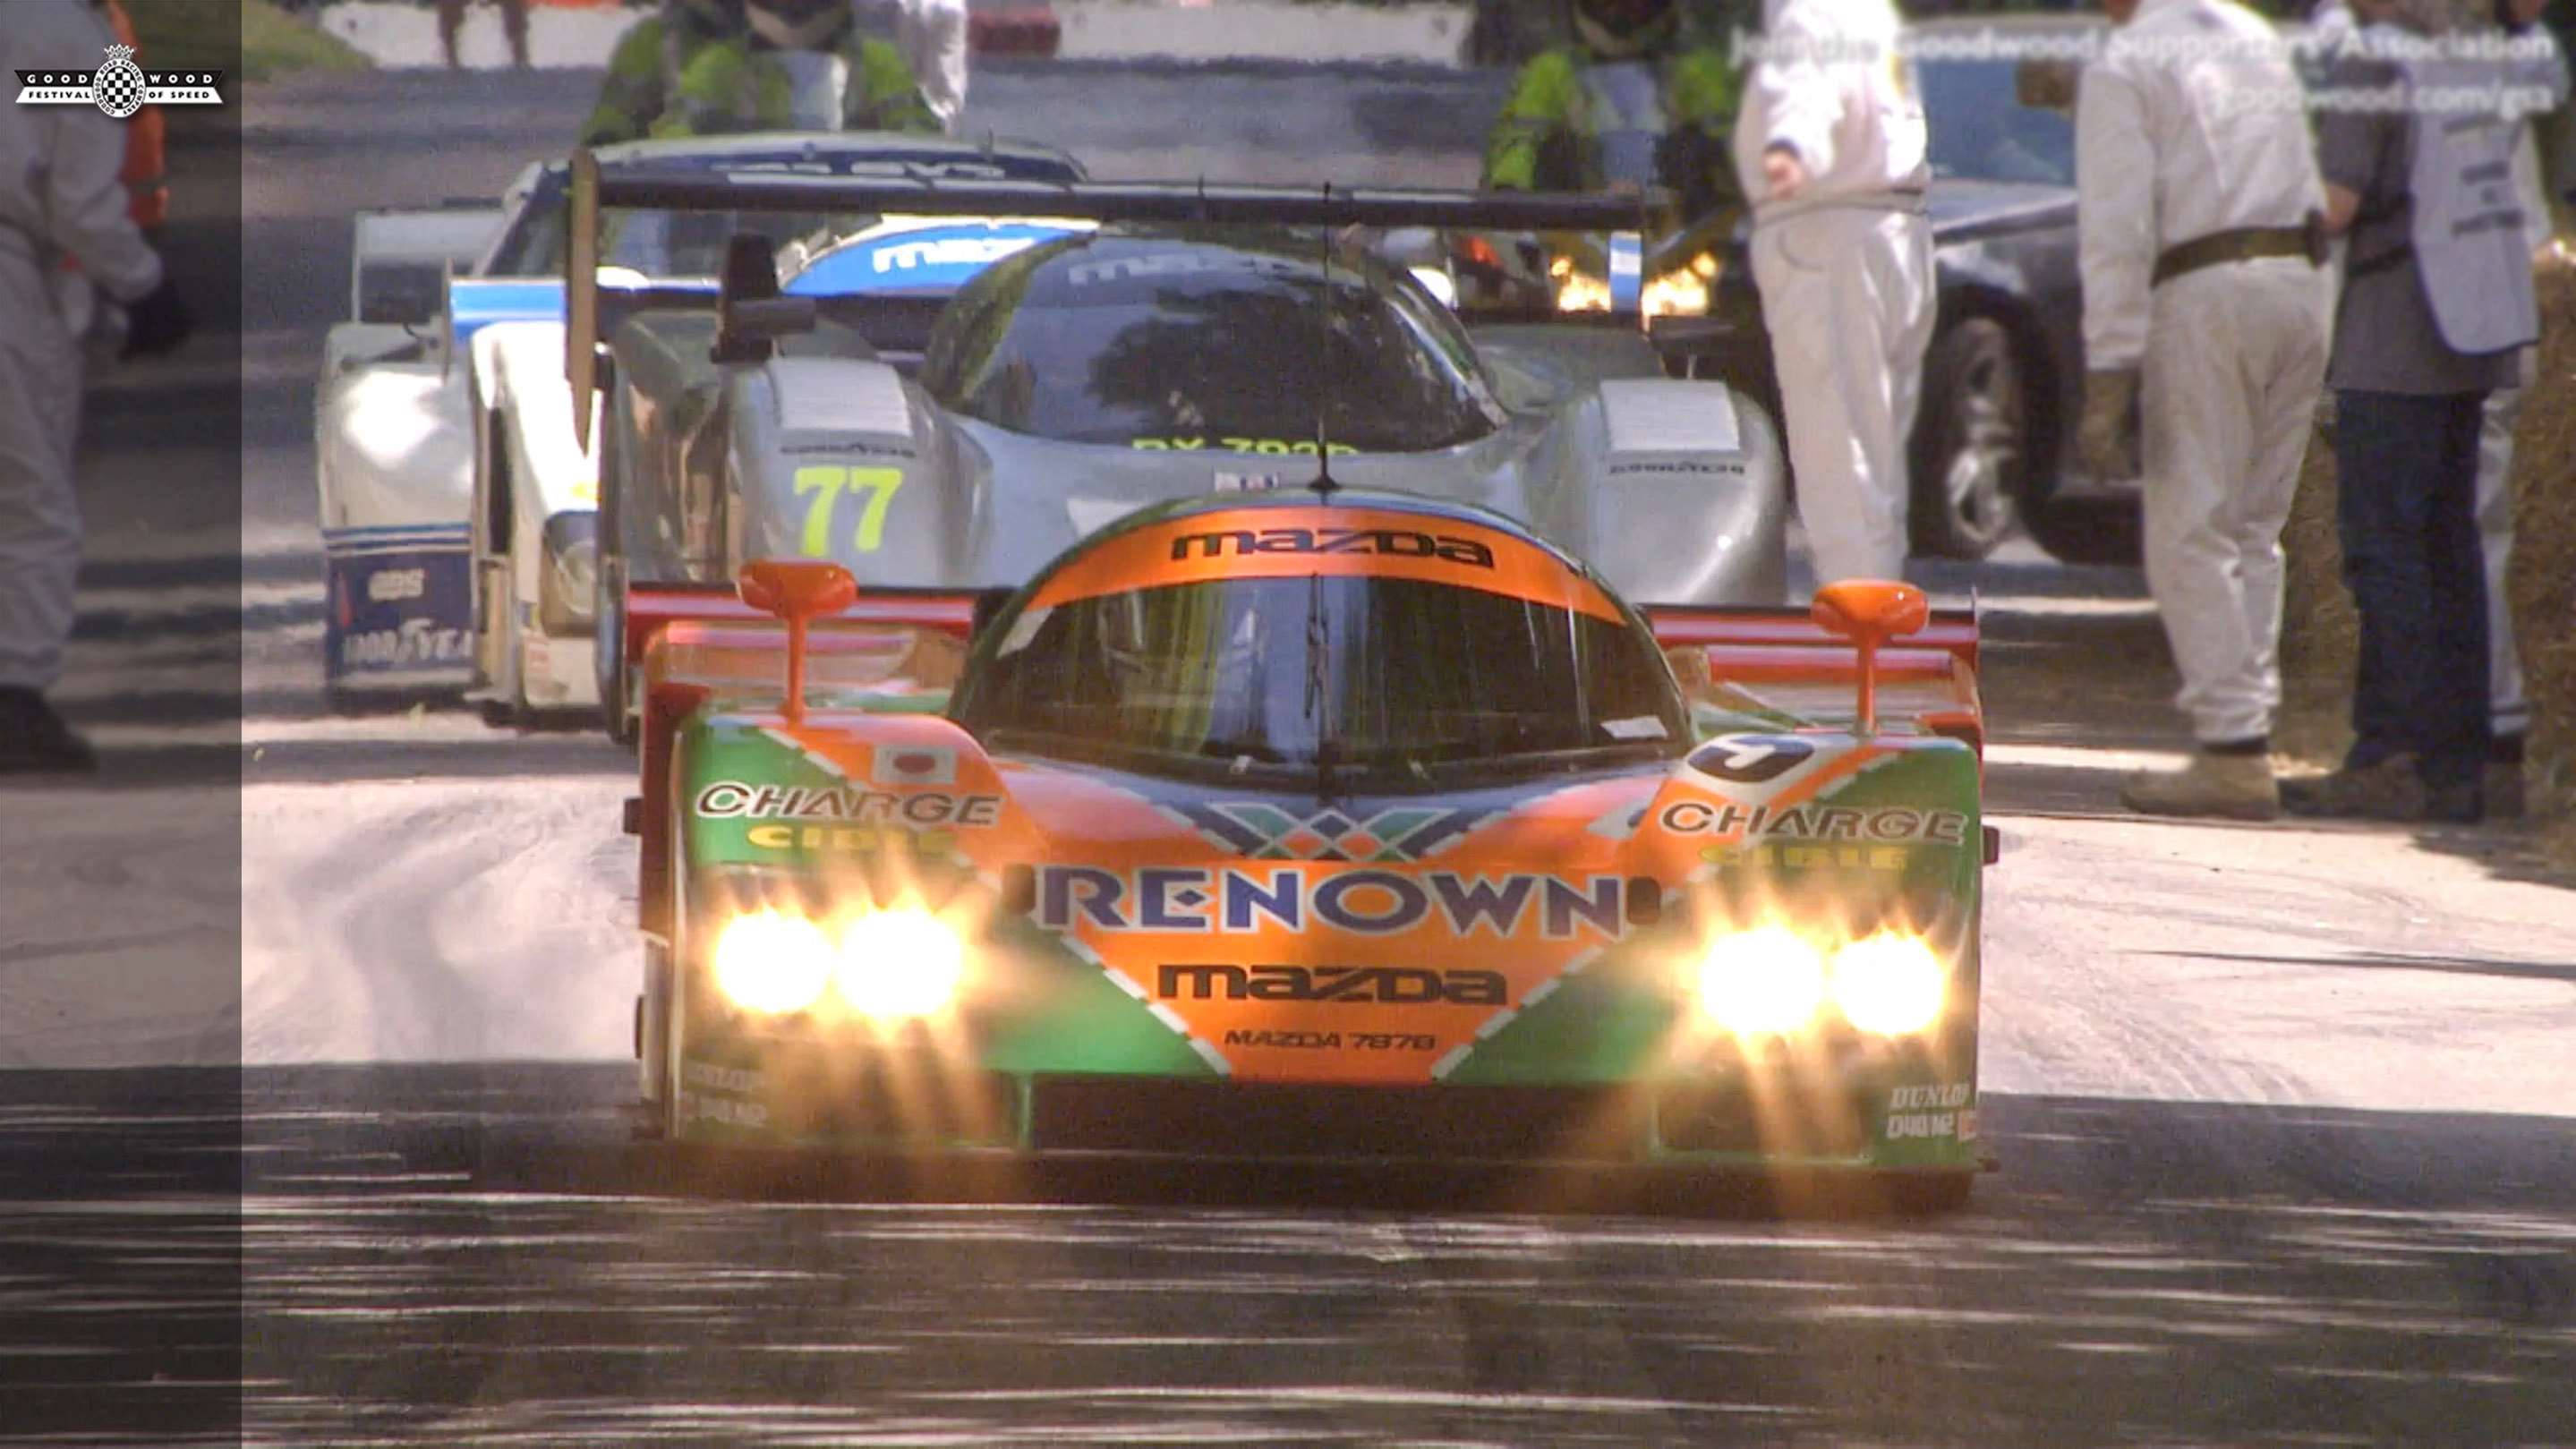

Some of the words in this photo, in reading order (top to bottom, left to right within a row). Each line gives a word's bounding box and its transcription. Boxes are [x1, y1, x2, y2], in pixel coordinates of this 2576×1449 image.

[793, 466, 904, 558] 77
[1171, 528, 1495, 569] mazda
[695, 780, 1003, 827] CHARGE
[1659, 801, 1969, 846] CHARGE
[1036, 865, 1625, 942] RENOWN
[1157, 964, 1507, 1007] mazda
[1224, 1028, 1342, 1049] MAZDA
